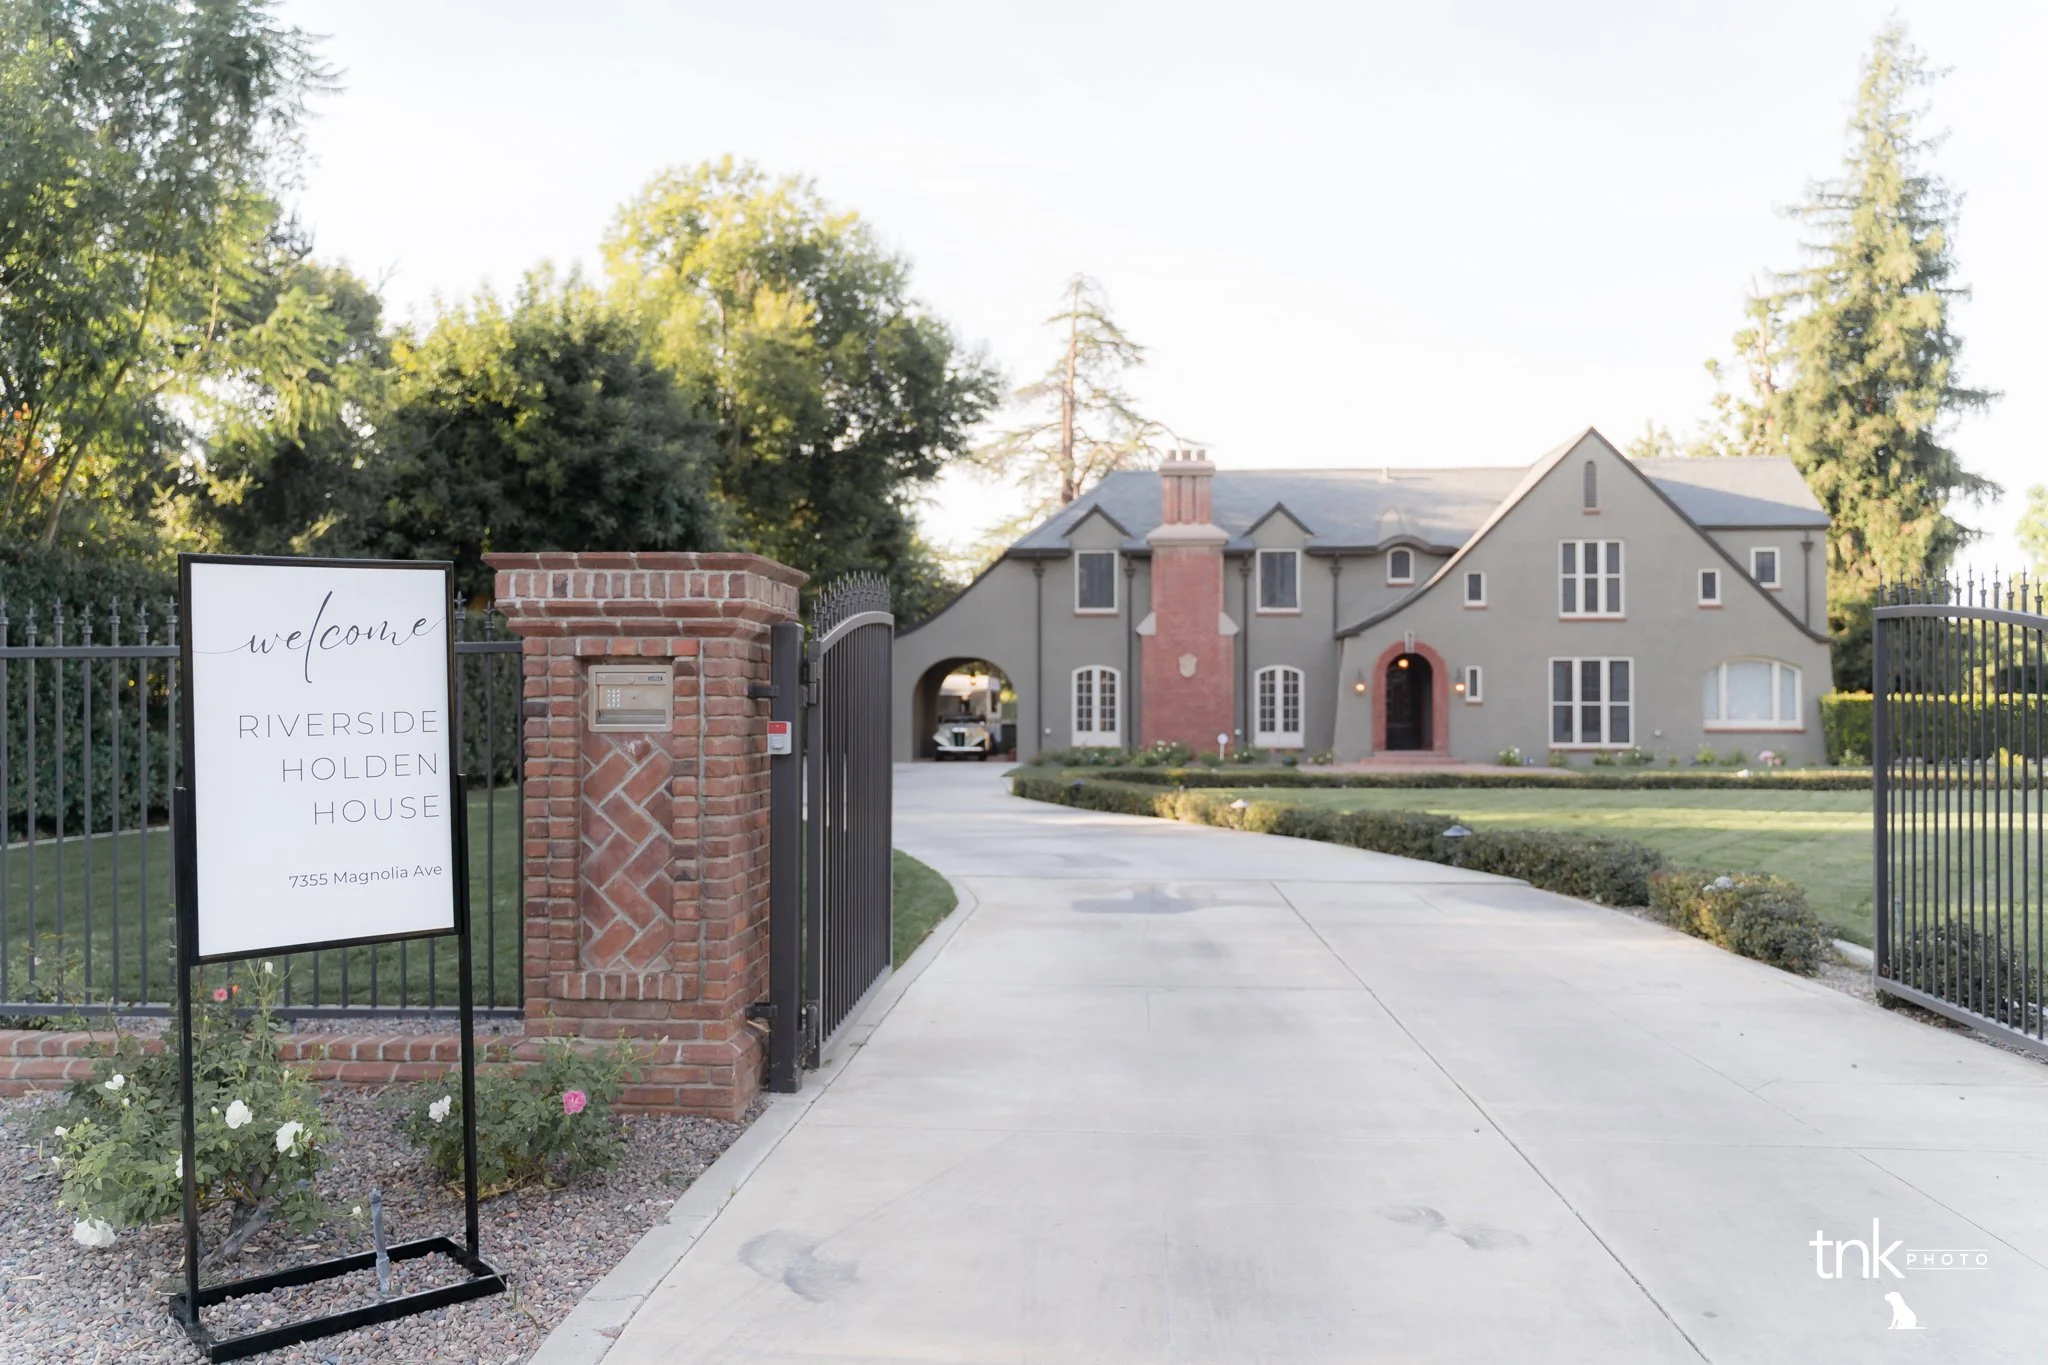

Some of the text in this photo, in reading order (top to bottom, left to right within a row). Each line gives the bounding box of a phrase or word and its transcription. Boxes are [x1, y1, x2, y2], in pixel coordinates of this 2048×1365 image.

[193, 591, 445, 683] welcome
[239, 710, 439, 739] RIVERSIDE
[282, 753, 438, 782] HOLDEN
[313, 795, 440, 825] HOUSE
[288, 863, 442, 888] 7355 Magnolia Ave
